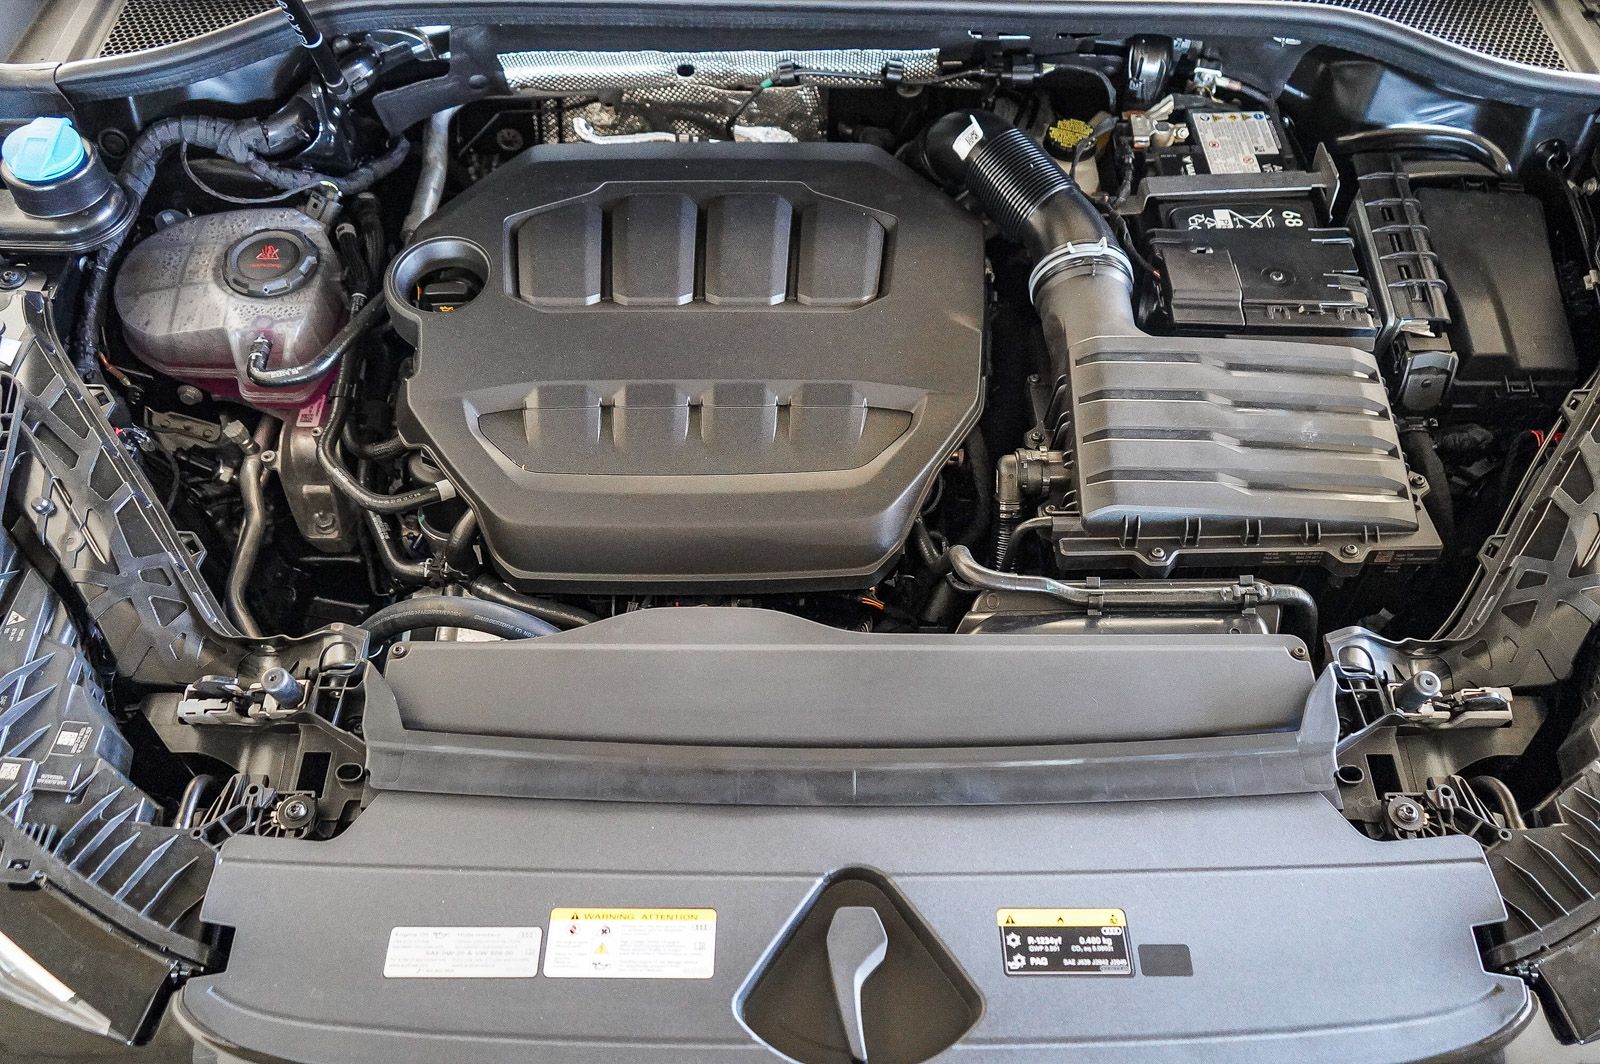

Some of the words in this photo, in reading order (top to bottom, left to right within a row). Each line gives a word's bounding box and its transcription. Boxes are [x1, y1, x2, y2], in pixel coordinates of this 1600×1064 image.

[1282, 210, 1304, 228] 68
[583, 913, 636, 921] WARNING
[641, 913, 699, 921] ATTENTION
[1103, 936, 1112, 946] kg
[1030, 957, 1048, 966] PAG
[1063, 958, 1076, 966] SAE
